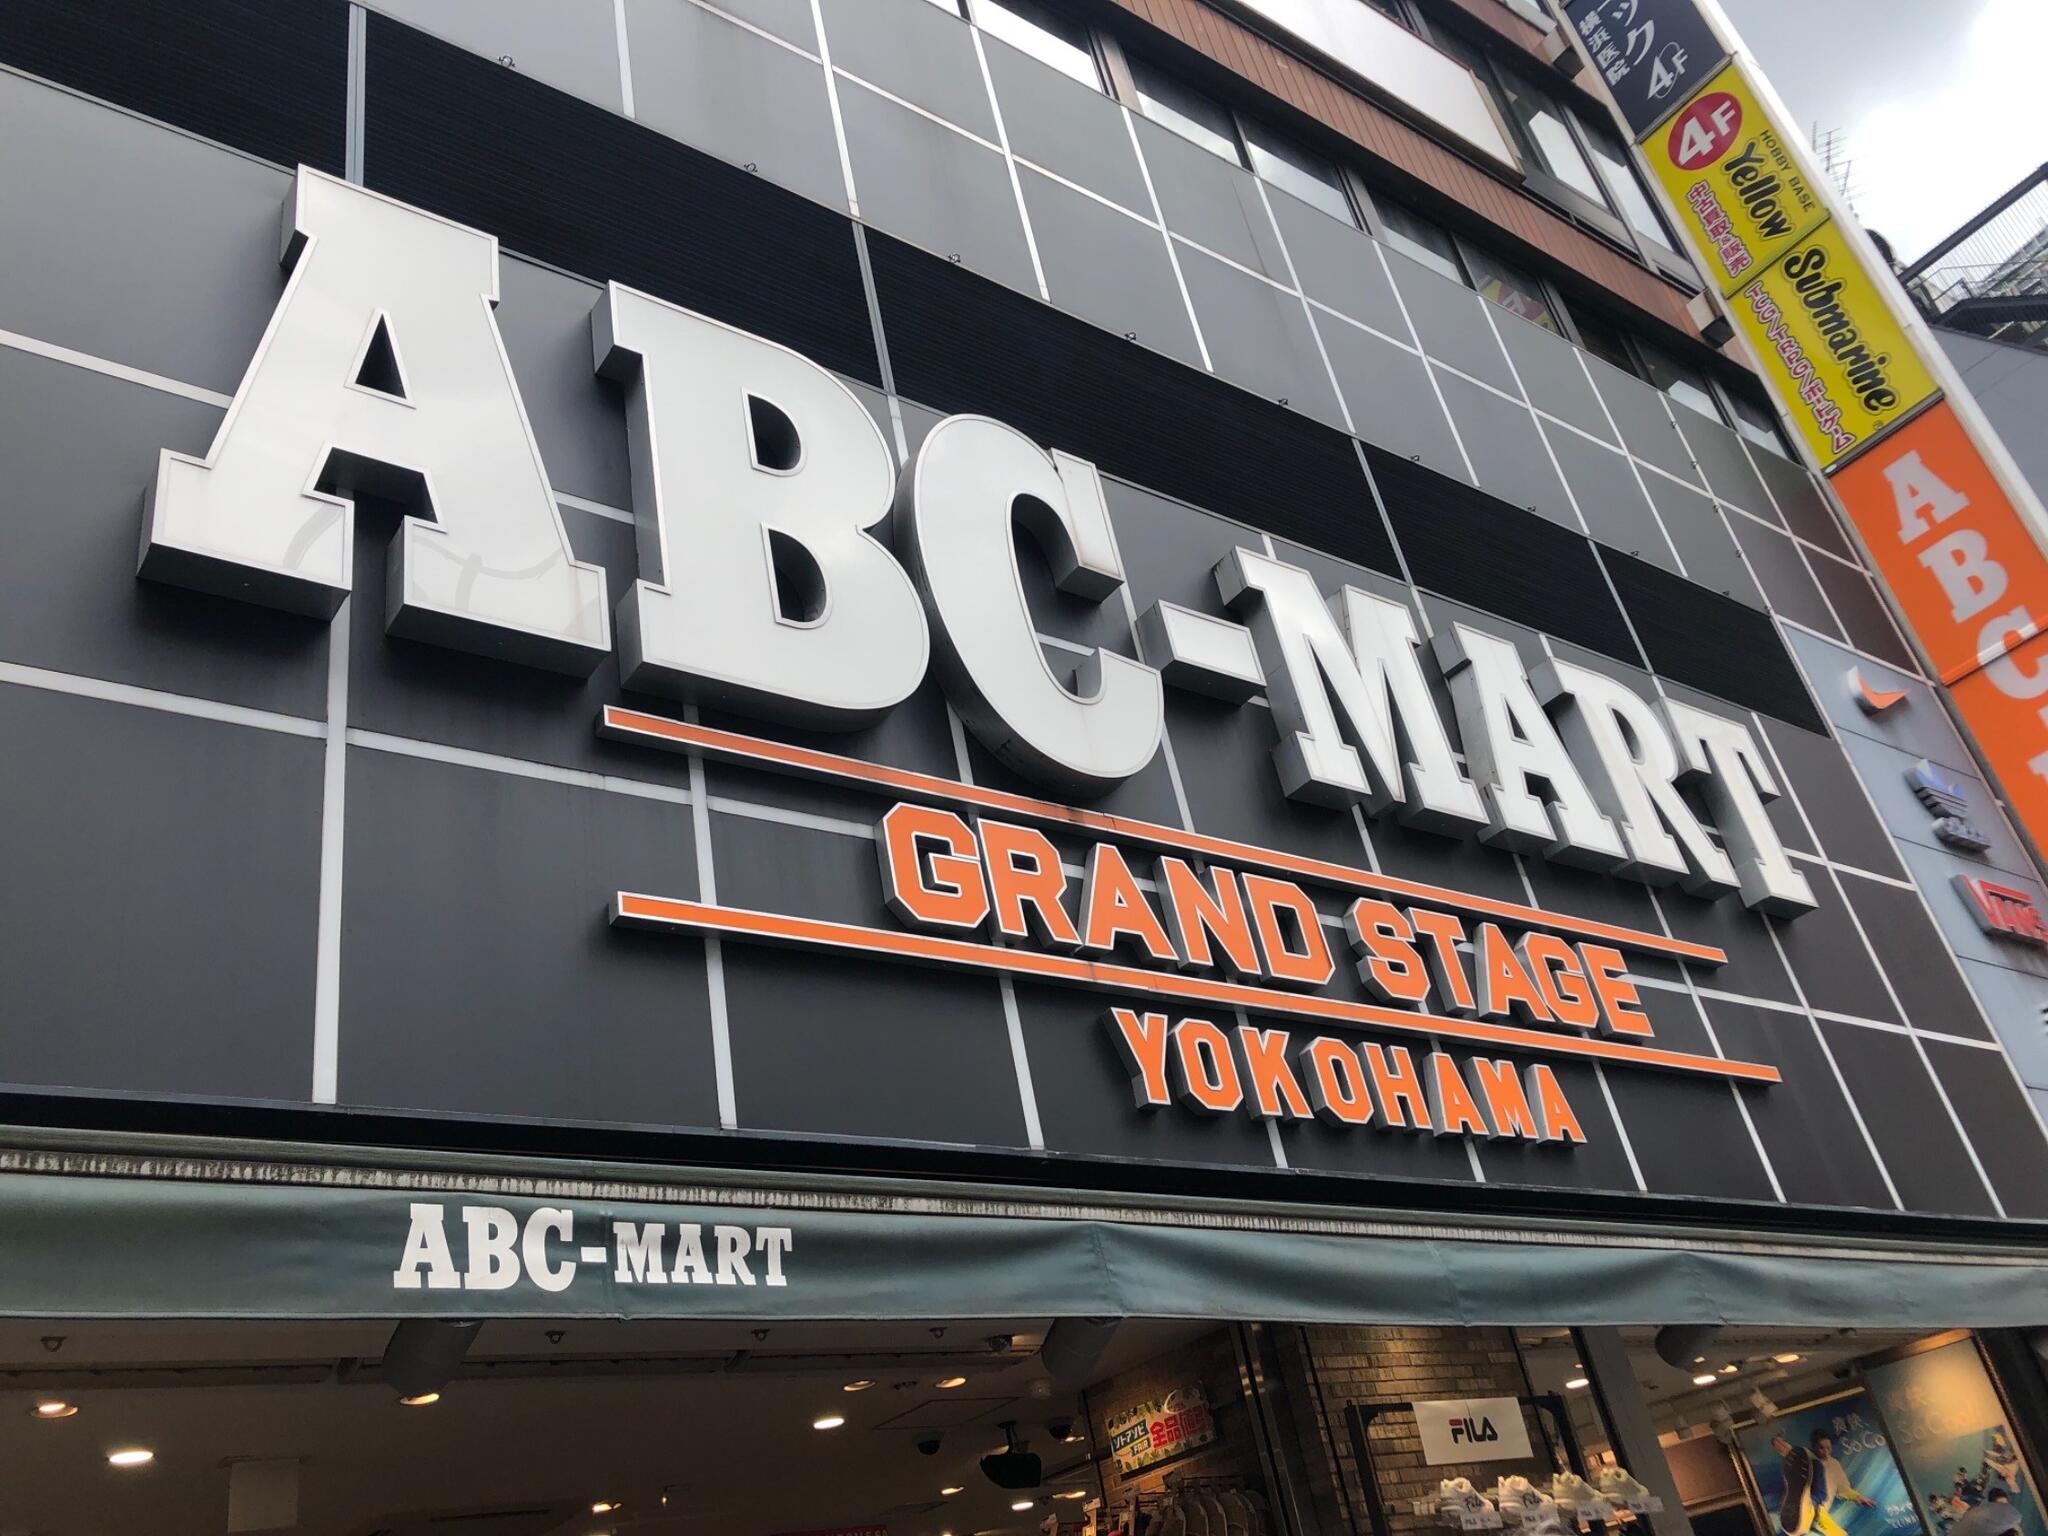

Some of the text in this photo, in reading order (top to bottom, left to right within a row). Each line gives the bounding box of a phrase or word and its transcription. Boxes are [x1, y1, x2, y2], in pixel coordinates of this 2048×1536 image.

[1579, 10, 1630, 86] 横浜医院
[1597, 0, 1655, 66] ック
[1647, 47, 1689, 99] 4F
[1677, 100, 1737, 167] 4F
[1760, 129, 1817, 213] HOBBY BASE
[1722, 141, 1793, 239] Yellow
[1784, 248, 1897, 412] Submarine
[140, 163, 1819, 918] ABC-MART
[1882, 450, 2048, 783] ABC
[877, 801, 1656, 1043] GRAND STAGE
[1104, 1007, 1588, 1147] YOKOHAMA
[393, 1203, 793, 1292] ABC-MART
[1448, 1416, 1498, 1444] FILA
